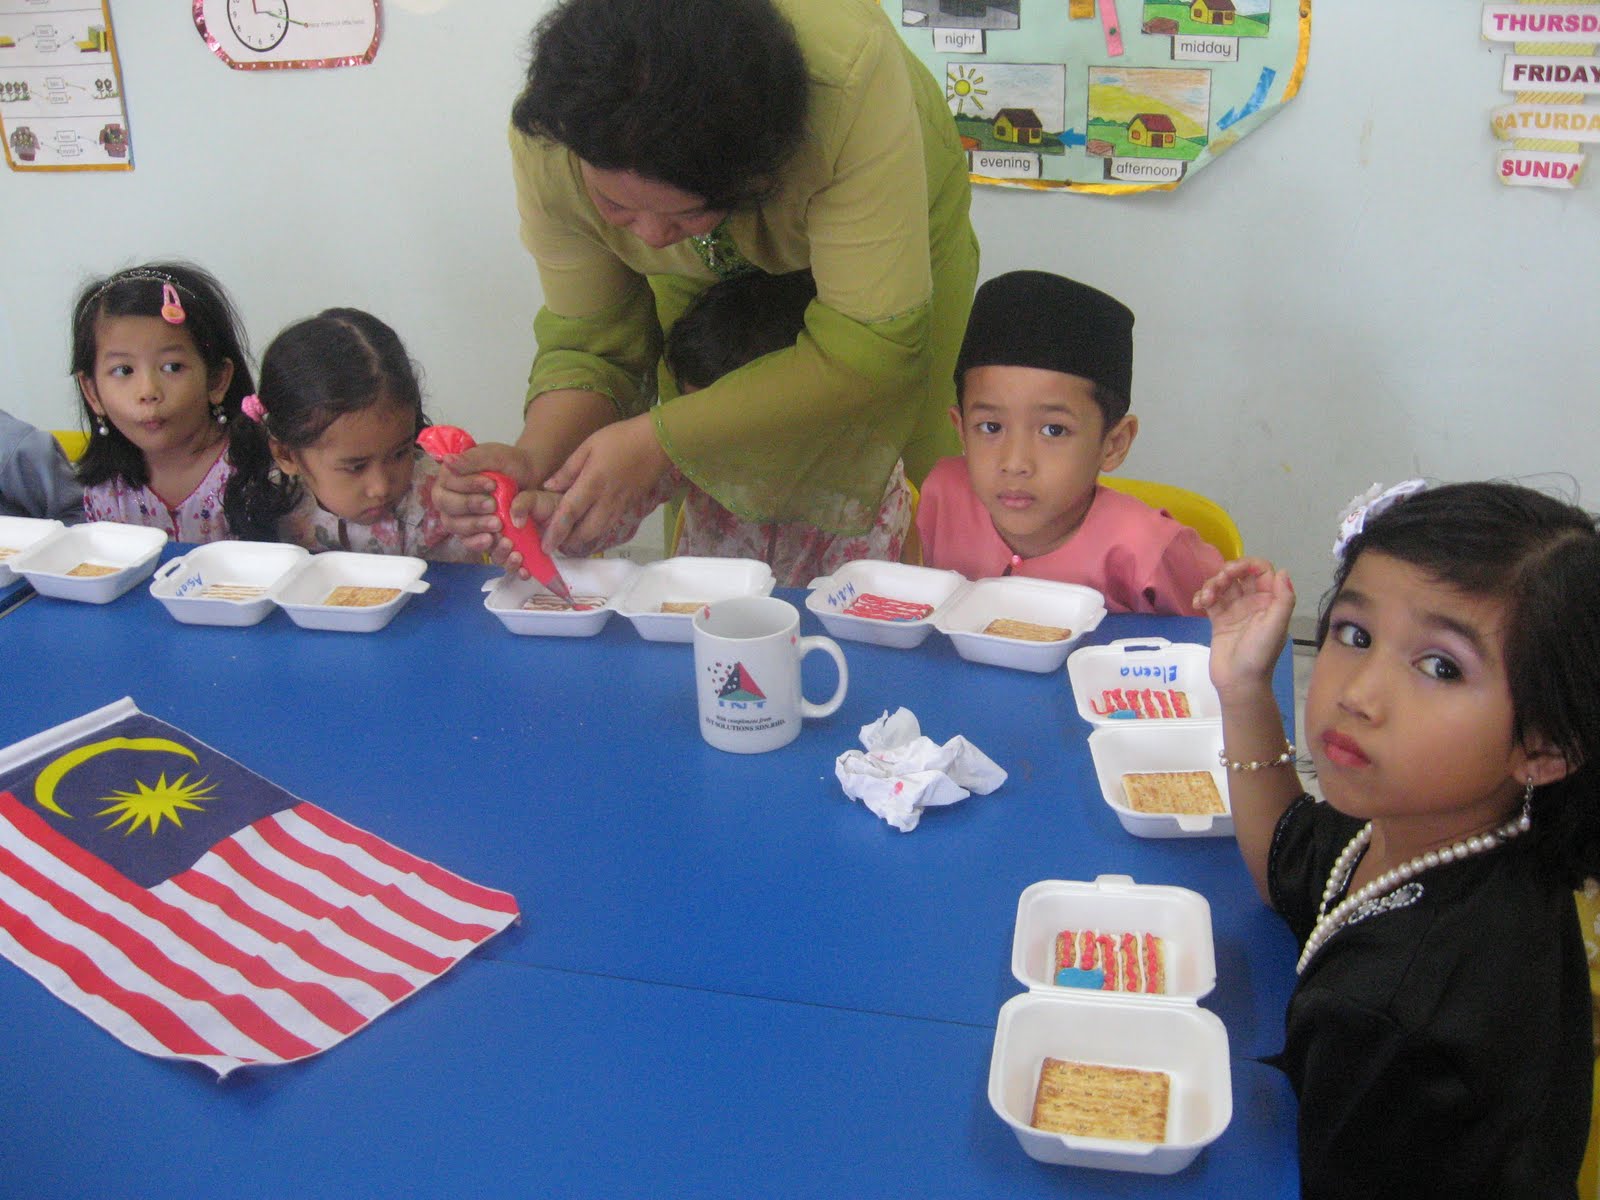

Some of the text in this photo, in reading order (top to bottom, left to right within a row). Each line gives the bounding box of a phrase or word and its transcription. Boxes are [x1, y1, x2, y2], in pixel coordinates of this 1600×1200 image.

[1493, 14, 1600, 33] THURSD
[945, 32, 976, 49] night
[1181, 39, 1232, 57] midday
[1513, 64, 1600, 83] FRIDAY
[980, 155, 1031, 172] evening
[1116, 161, 1178, 178] afternoon
[1120, 665, 1177, 684] Eleena
[719, 700, 767, 709] INT
[715, 721, 754, 731] SOLUTIONS
